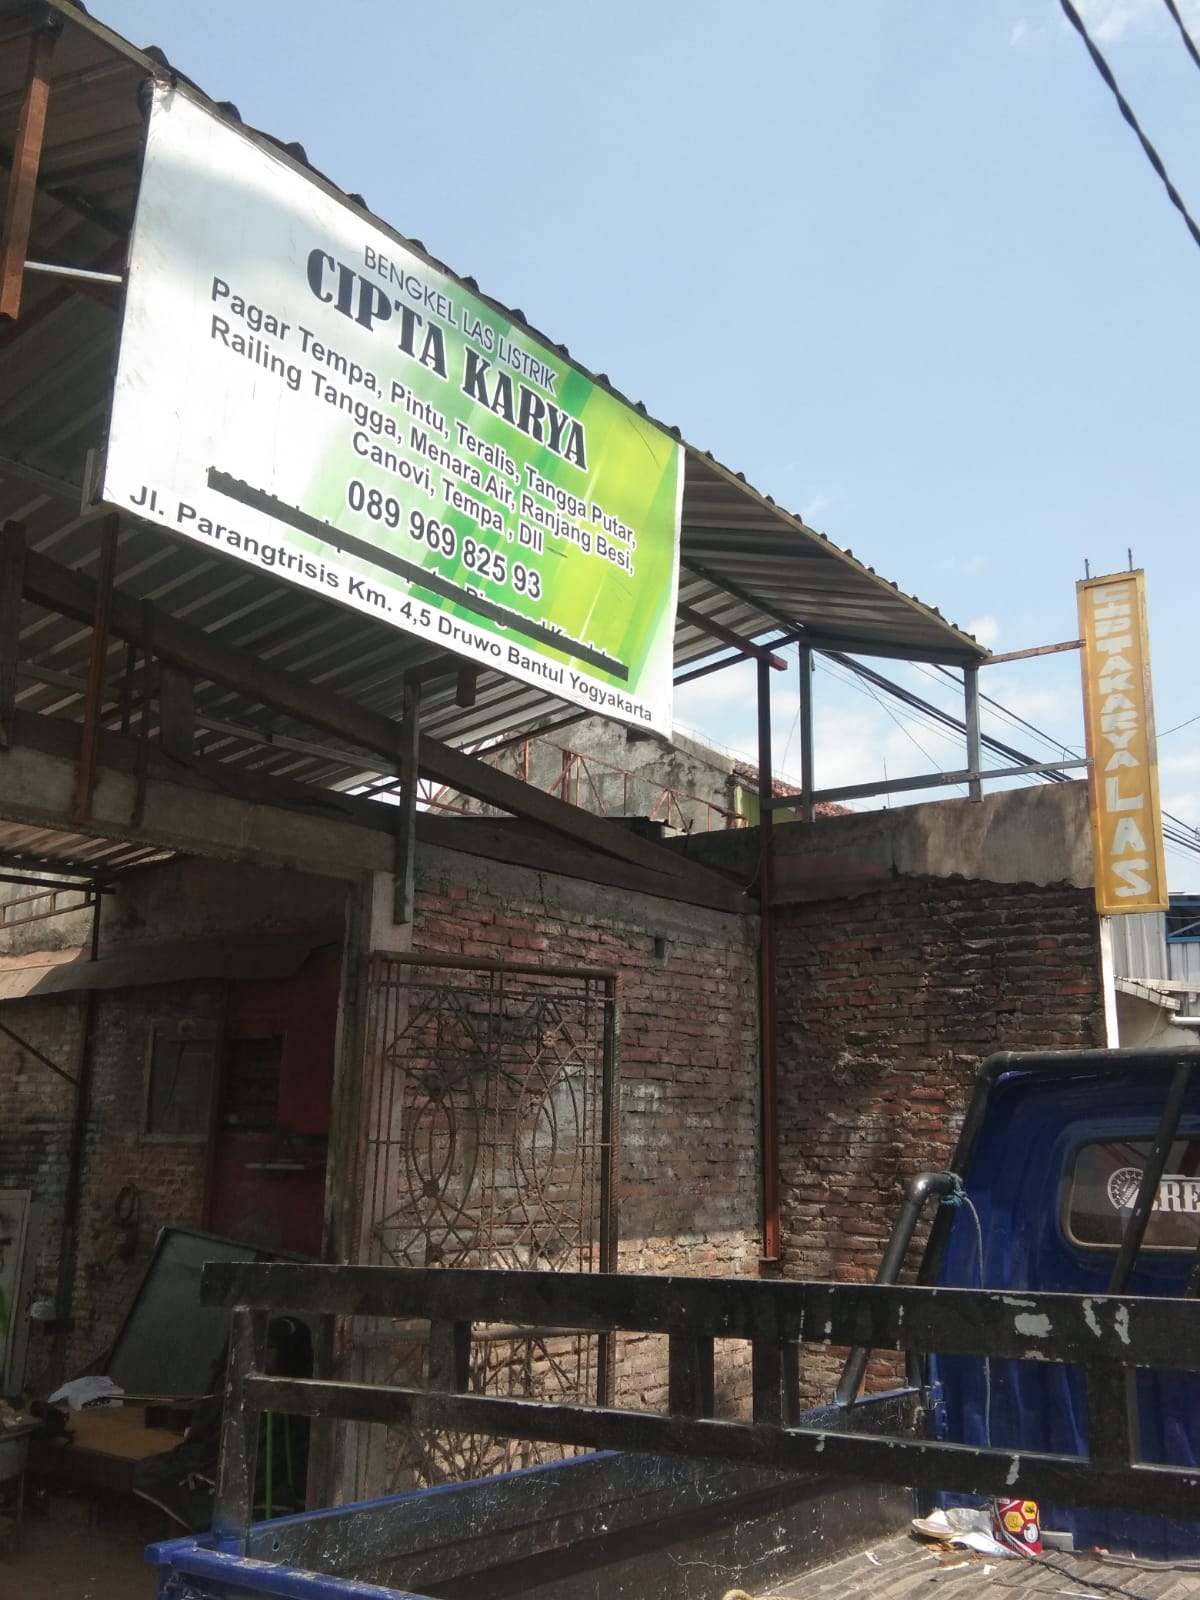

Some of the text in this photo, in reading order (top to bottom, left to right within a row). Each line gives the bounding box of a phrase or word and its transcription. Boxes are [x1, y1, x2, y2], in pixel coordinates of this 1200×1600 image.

[211, 276, 636, 548] Pagar Tempa, Pintu, Teralis, Tangga Putar,
[307, 248, 587, 470] CIPTA KARYA
[365, 245, 555, 392] BENGKEL LAS LISTRIK
[211, 314, 633, 574] Railing Tangga, Menara Air, Ranjang Besi,
[349, 480, 541, 598] 089 969 825 93
[353, 432, 434, 495] Canovi,
[130, 486, 652, 722] Jl. Parangtrisis Km. 4,5 Druwo Bantul Yogyakarta
